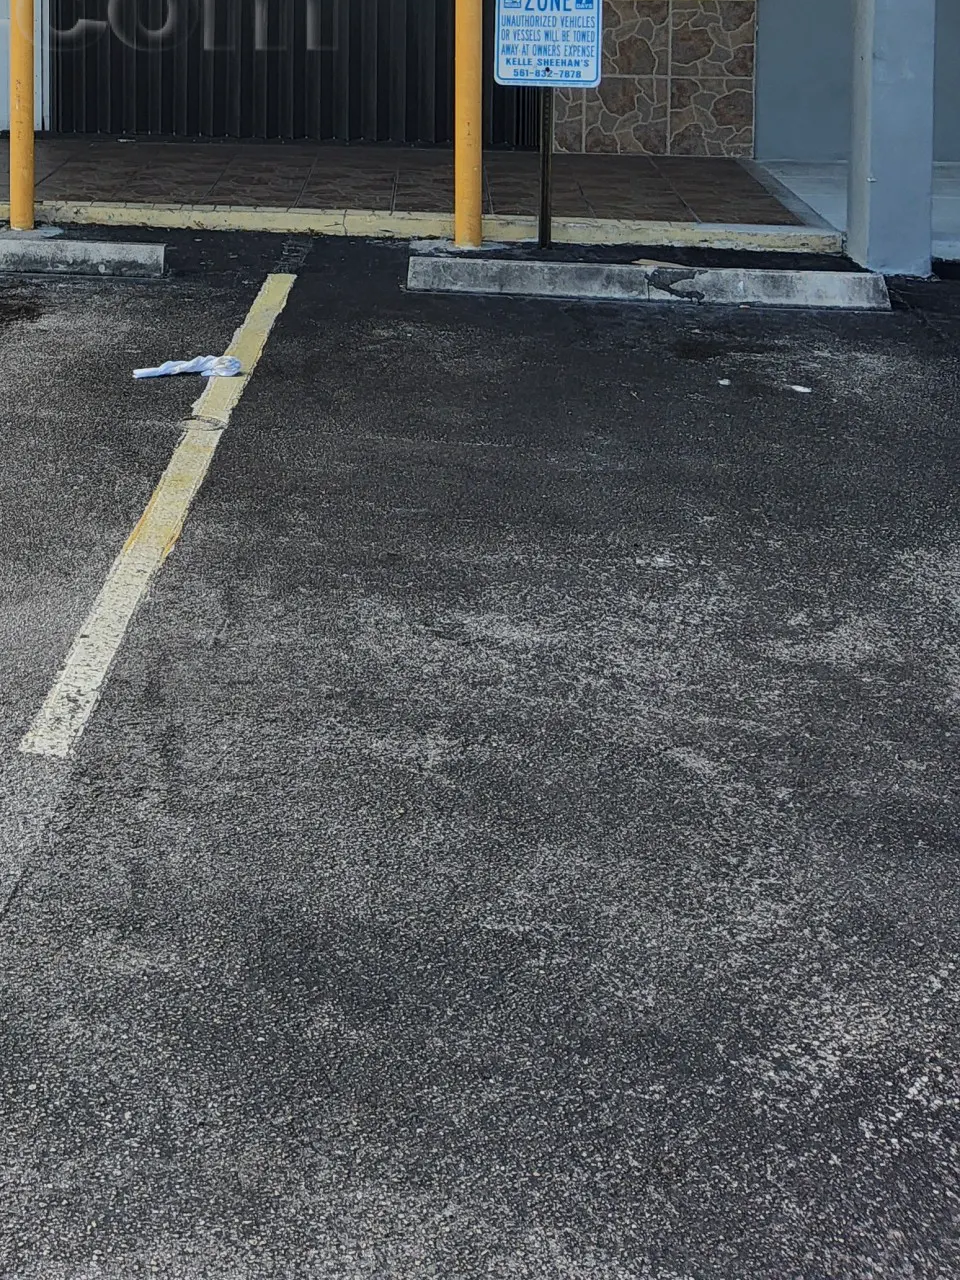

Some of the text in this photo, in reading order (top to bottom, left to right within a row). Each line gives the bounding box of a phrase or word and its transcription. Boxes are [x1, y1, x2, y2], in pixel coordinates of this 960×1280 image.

[501, 15, 596, 28] UNAUTHORIZED VEHICLES
[501, 29, 595, 43] OR VESSELS WILL BE TOWED
[501, 44, 595, 58] AWAY AT OWNERS EXPENSE
[505, 57, 590, 67] KELLE SHEEHAN'S
[513, 68, 582, 79] 561-832-7878
